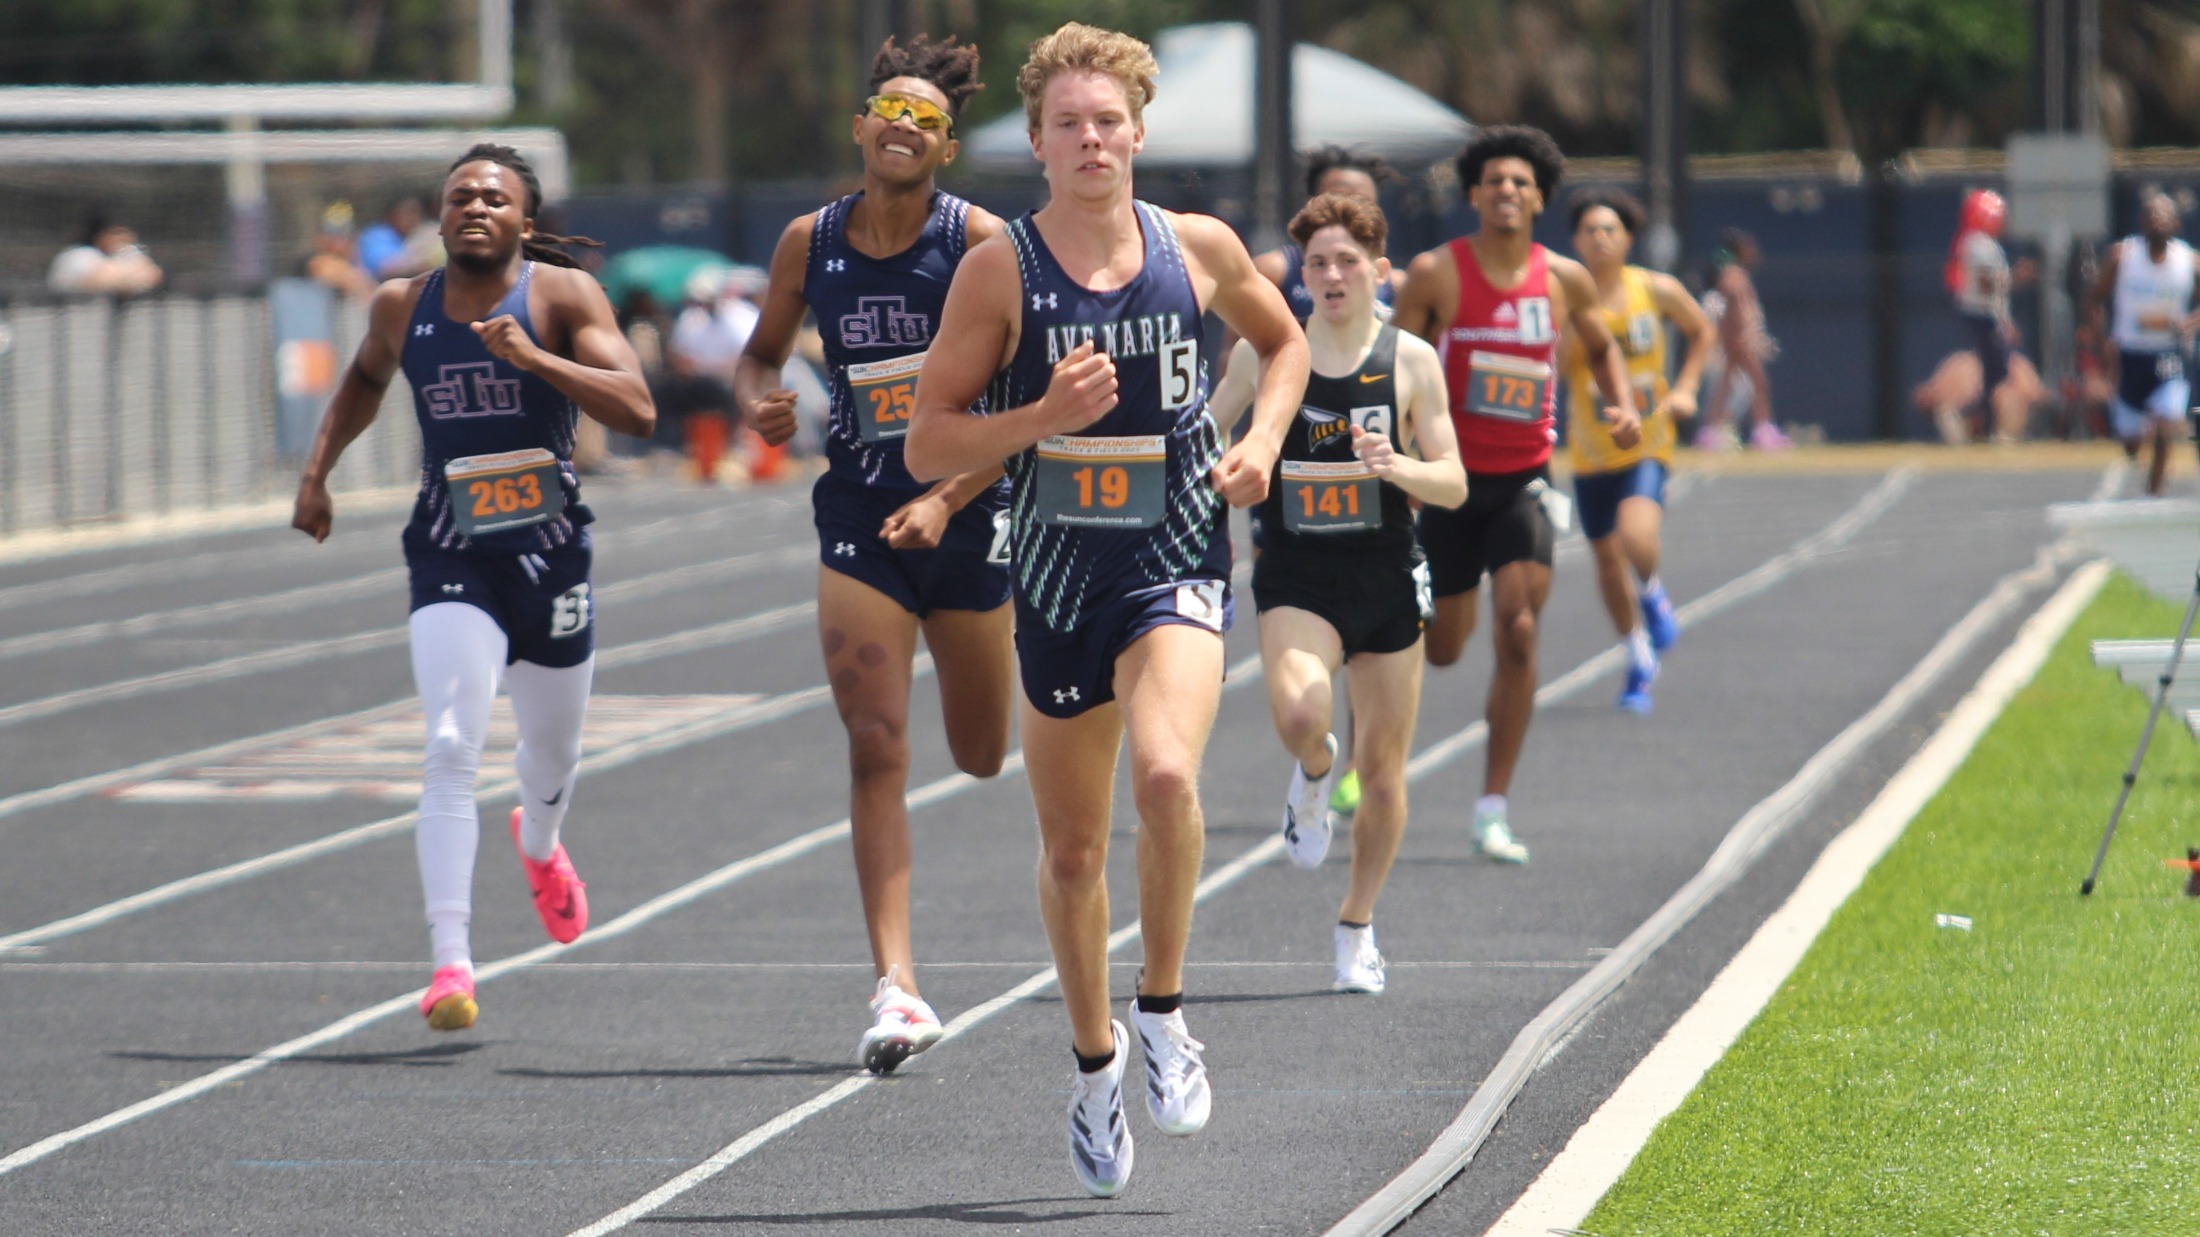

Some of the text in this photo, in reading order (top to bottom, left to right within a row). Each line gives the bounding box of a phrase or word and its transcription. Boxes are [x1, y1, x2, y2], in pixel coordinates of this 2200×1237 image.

[840, 296, 930, 348] STU
[1102, 313, 1182, 358] MARIA
[1528, 303, 1542, 339] 1
[421, 361, 521, 420] STU
[1170, 346, 1191, 405] 5
[1483, 374, 1537, 410] 173
[869, 383, 916, 424] 25
[468, 472, 543, 518] 263
[1072, 465, 1130, 509] 19
[1297, 483, 1360, 518] 141
[1056, 513, 1143, 524] thesunconference.com
